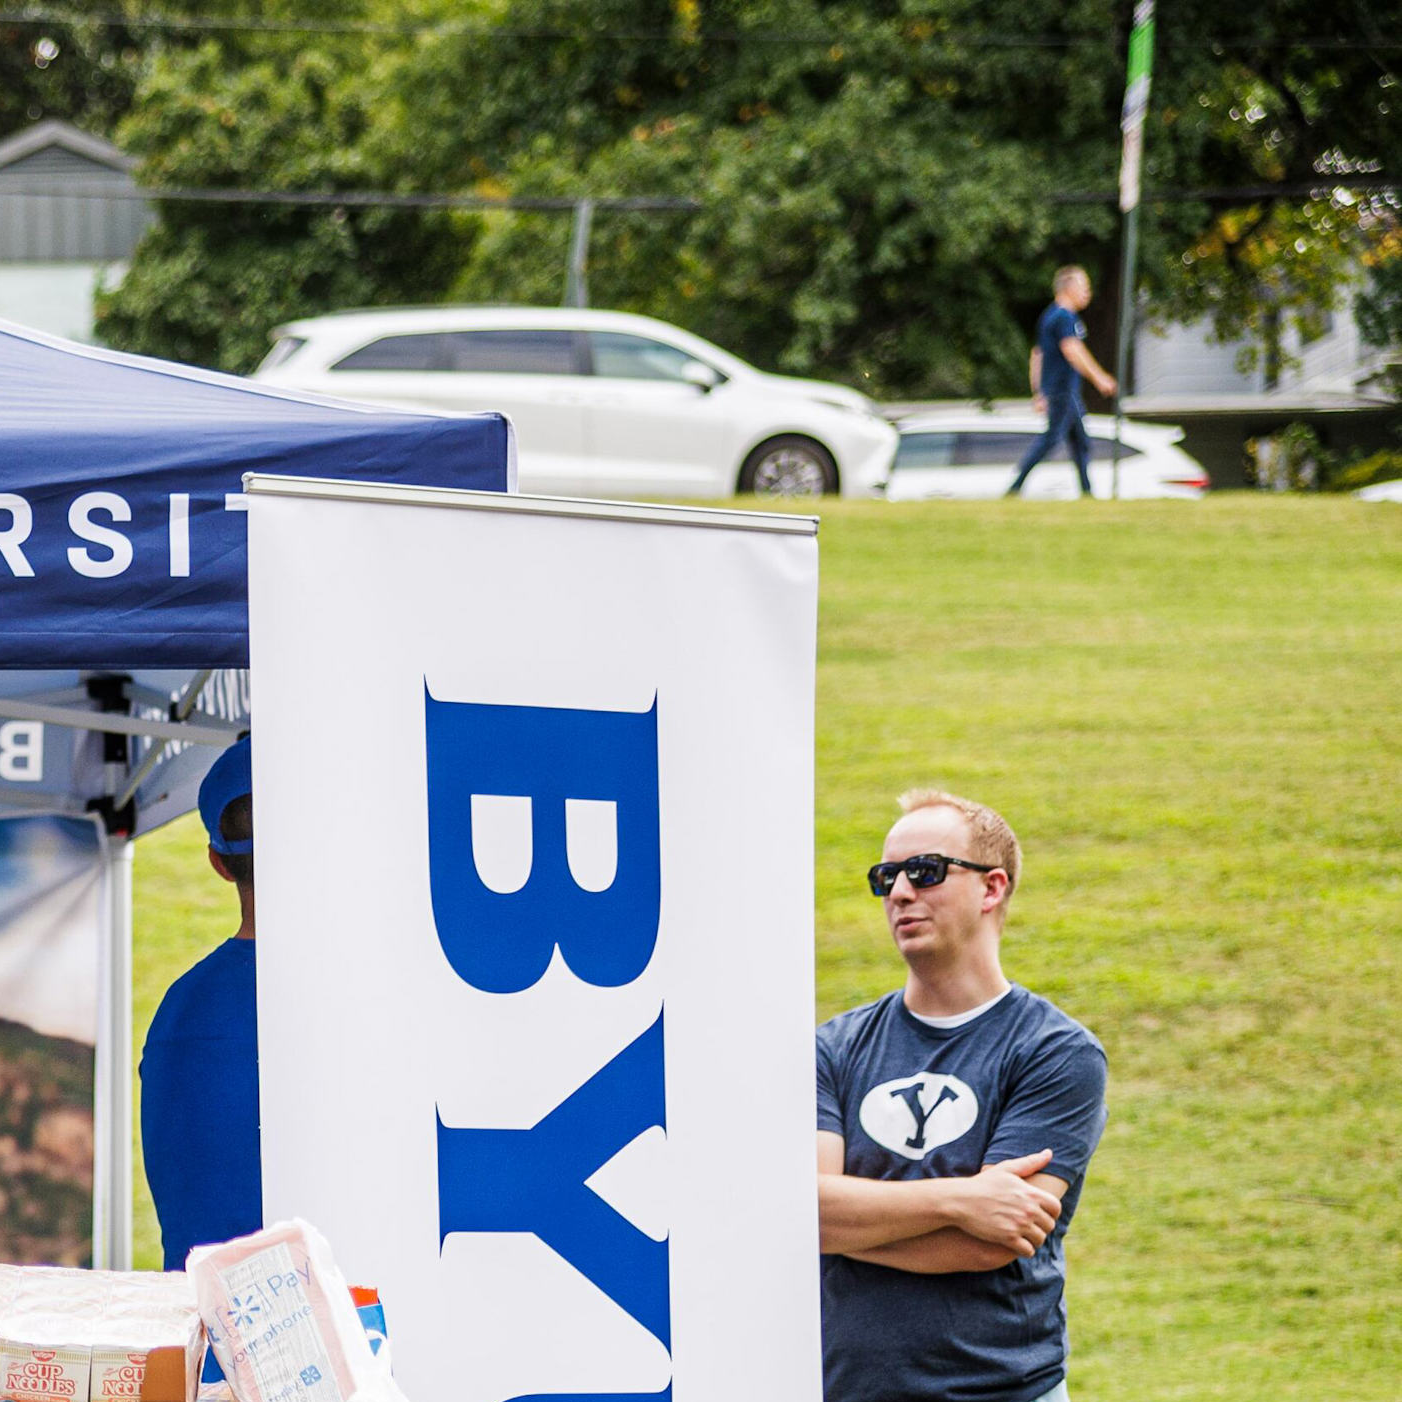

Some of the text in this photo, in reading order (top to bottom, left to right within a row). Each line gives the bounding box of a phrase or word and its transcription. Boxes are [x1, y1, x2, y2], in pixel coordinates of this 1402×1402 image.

[889, 1082, 959, 1150] Y
[267, 1260, 310, 1297] Pay
[263, 1306, 314, 1345] phone
[6, 1374, 75, 1396] NOODLES
[23, 1363, 63, 1380] CUP
[16, 1393, 50, 1401] CHICKEN
